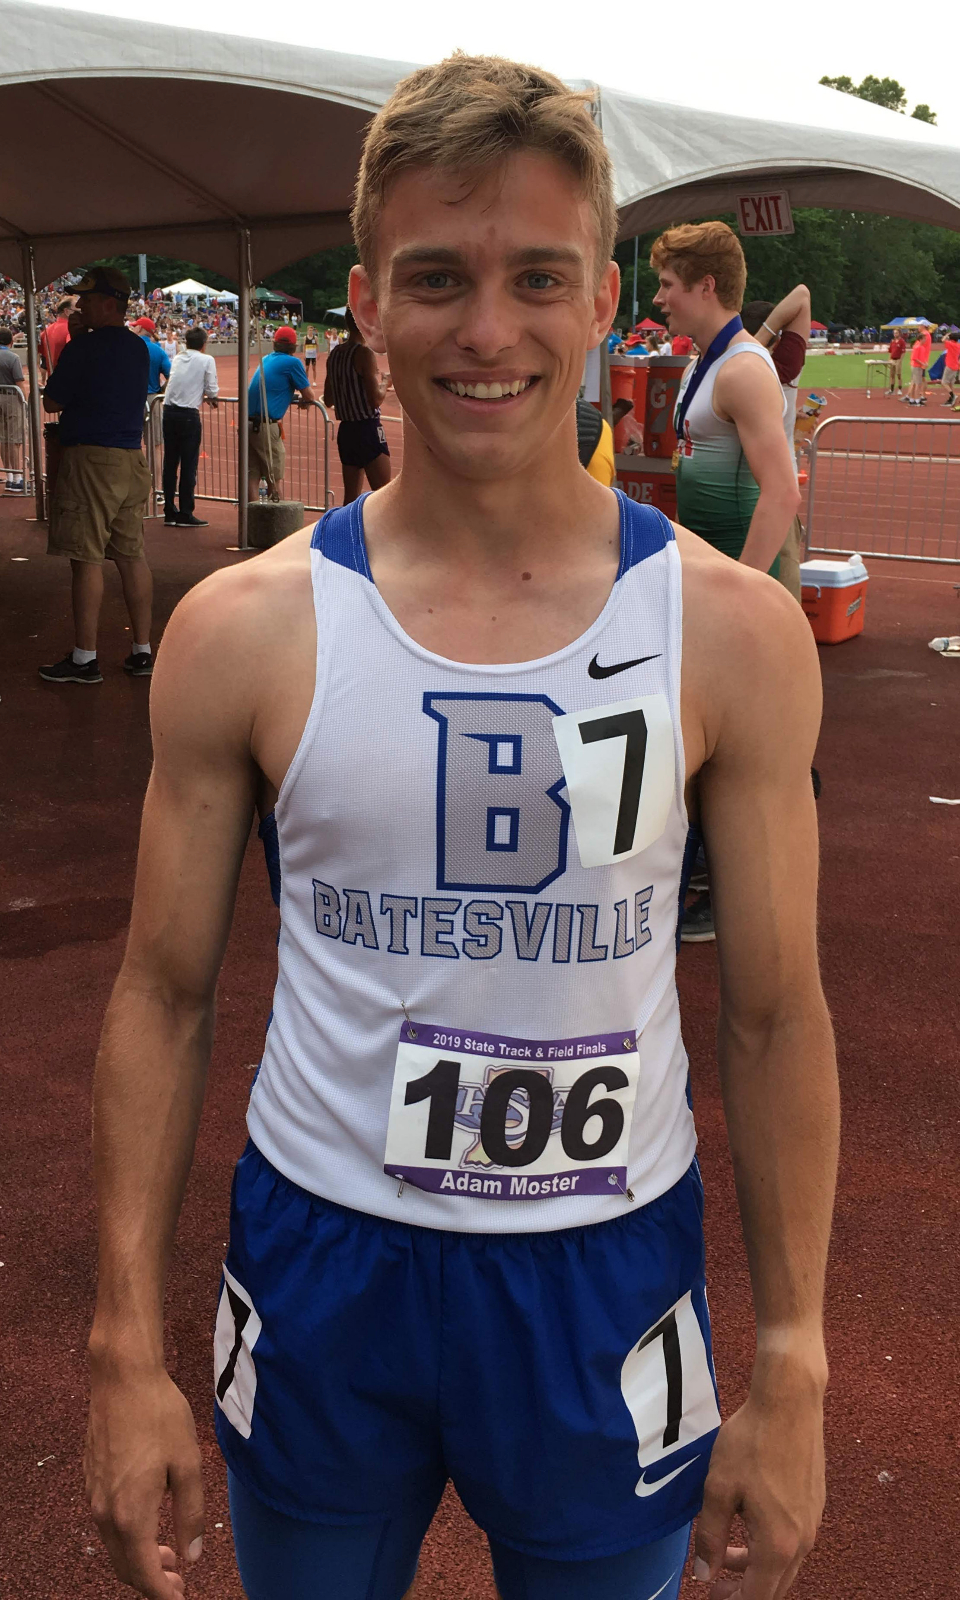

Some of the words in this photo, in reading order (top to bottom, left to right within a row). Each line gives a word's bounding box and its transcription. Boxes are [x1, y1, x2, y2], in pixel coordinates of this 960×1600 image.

[739, 195, 783, 231] EXIT
[422, 691, 571, 895] B
[577, 709, 648, 856] 7
[312, 878, 655, 963] BATESVILLE
[433, 1032, 461, 1049] 2019
[464, 1038, 495, 1054] State
[498, 1043, 532, 1058] Track
[535, 1047, 544, 1058] &
[547, 1046, 574, 1058] Field
[576, 1041, 607, 1055] Finals
[404, 1059, 630, 1168] 106
[440, 1171, 502, 1194] Adam
[509, 1175, 580, 1195] Moster
[636, 1309, 683, 1450] 7
